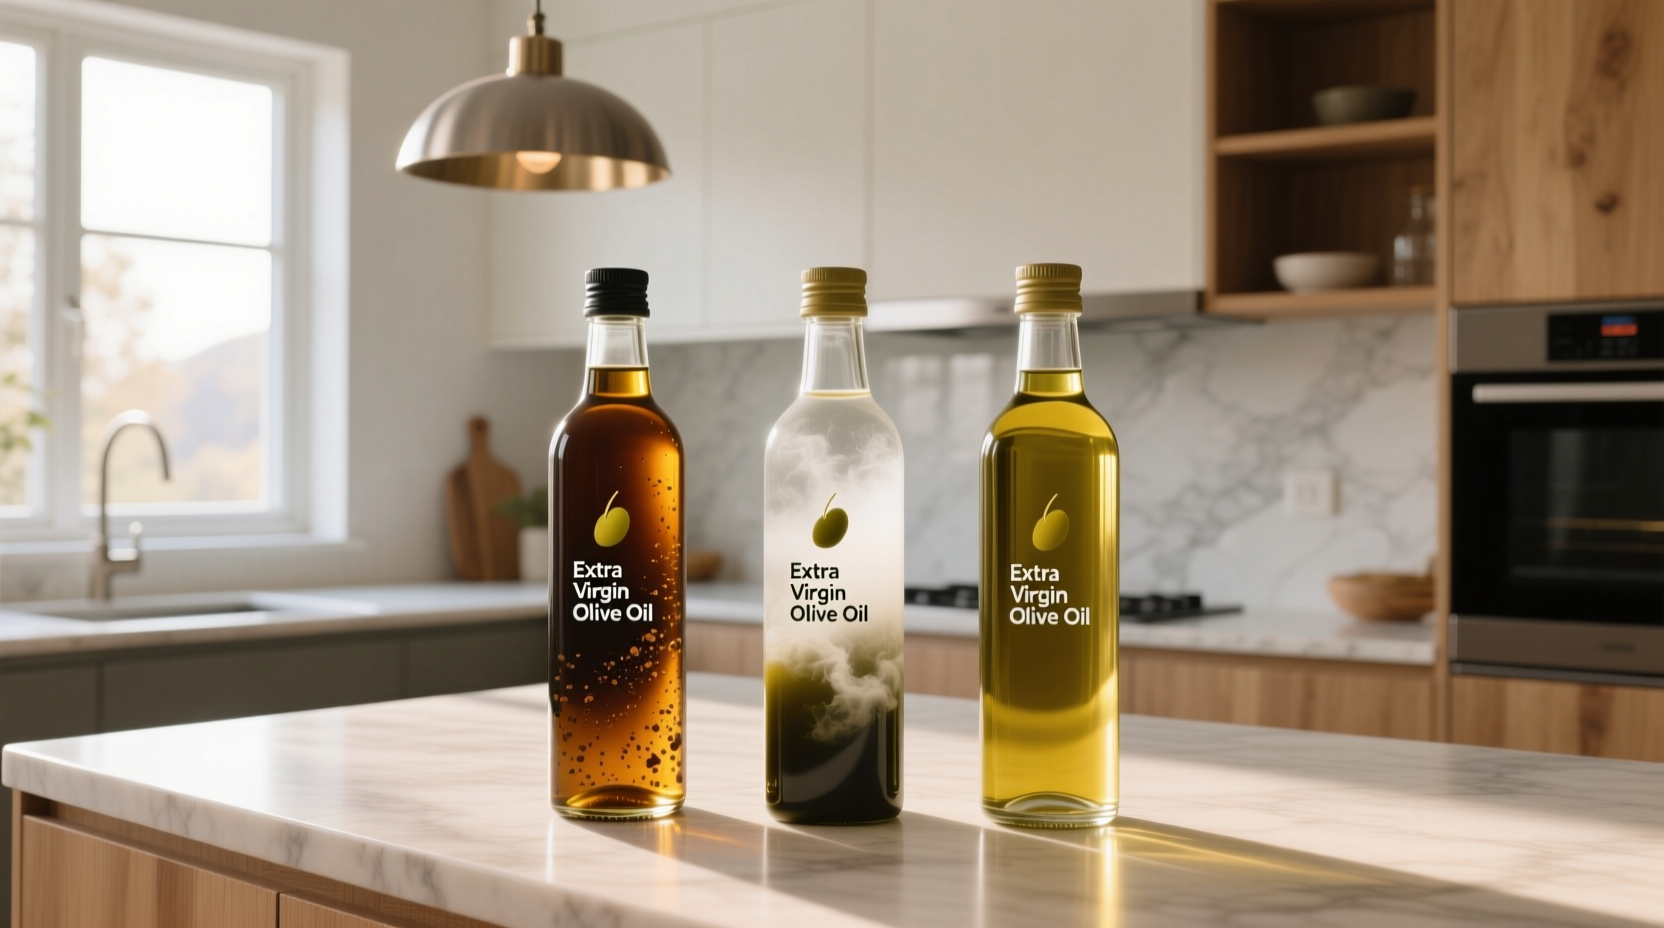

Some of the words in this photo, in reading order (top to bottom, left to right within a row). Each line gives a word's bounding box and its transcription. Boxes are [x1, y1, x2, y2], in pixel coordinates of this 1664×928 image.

[573, 561, 622, 578] Extra
[790, 562, 839, 579] Extra
[1010, 563, 1060, 581] Extra
[573, 582, 629, 603] Virgin
[790, 583, 846, 605] Virgin
[1010, 585, 1068, 607] Virgin
[573, 603, 622, 621] Olive
[626, 603, 653, 621] Oil
[790, 604, 838, 622] Olive
[843, 604, 868, 622] Oil
[1009, 606, 1059, 625] Olive
[1064, 607, 1091, 625] Oil
